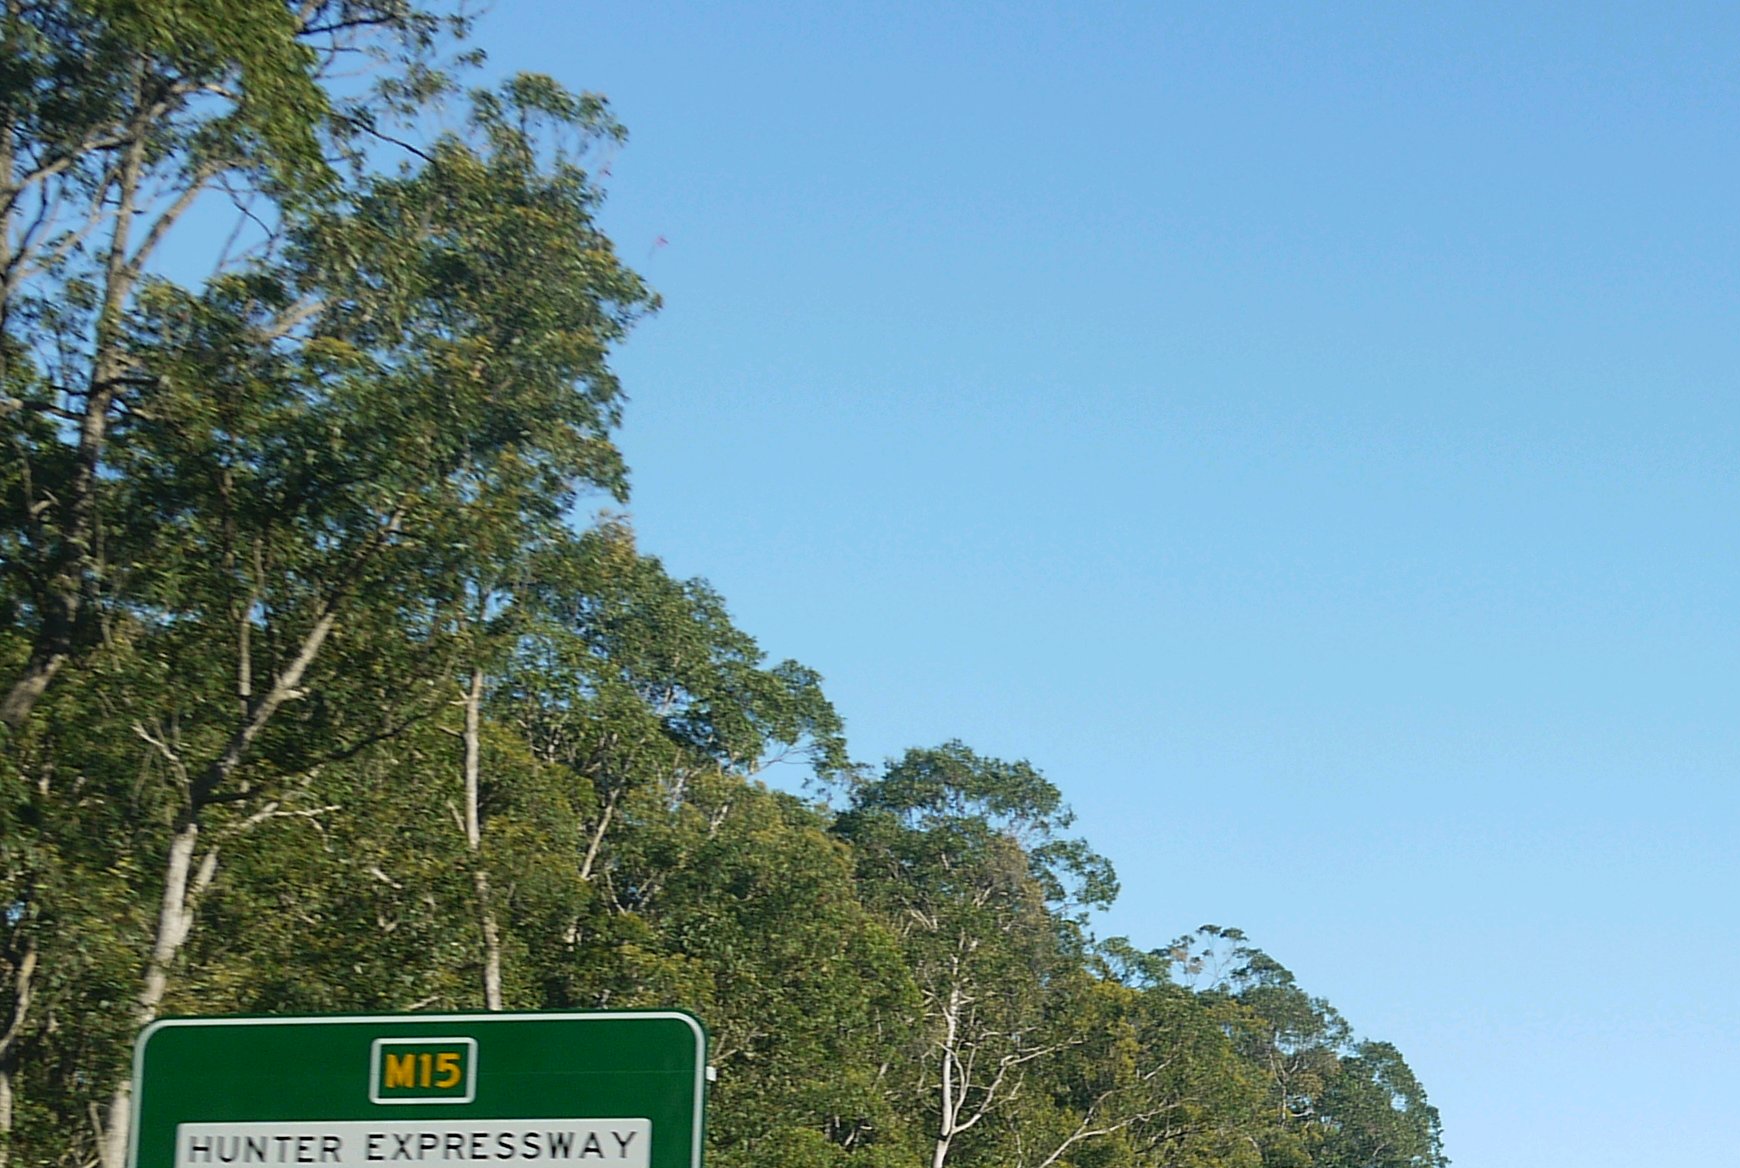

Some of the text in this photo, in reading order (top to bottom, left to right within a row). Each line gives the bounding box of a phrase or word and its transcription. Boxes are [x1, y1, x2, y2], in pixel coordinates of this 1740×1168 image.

[385, 1052, 461, 1088] M15
[188, 1131, 637, 1163] HUNTER EXPRESSWAY
